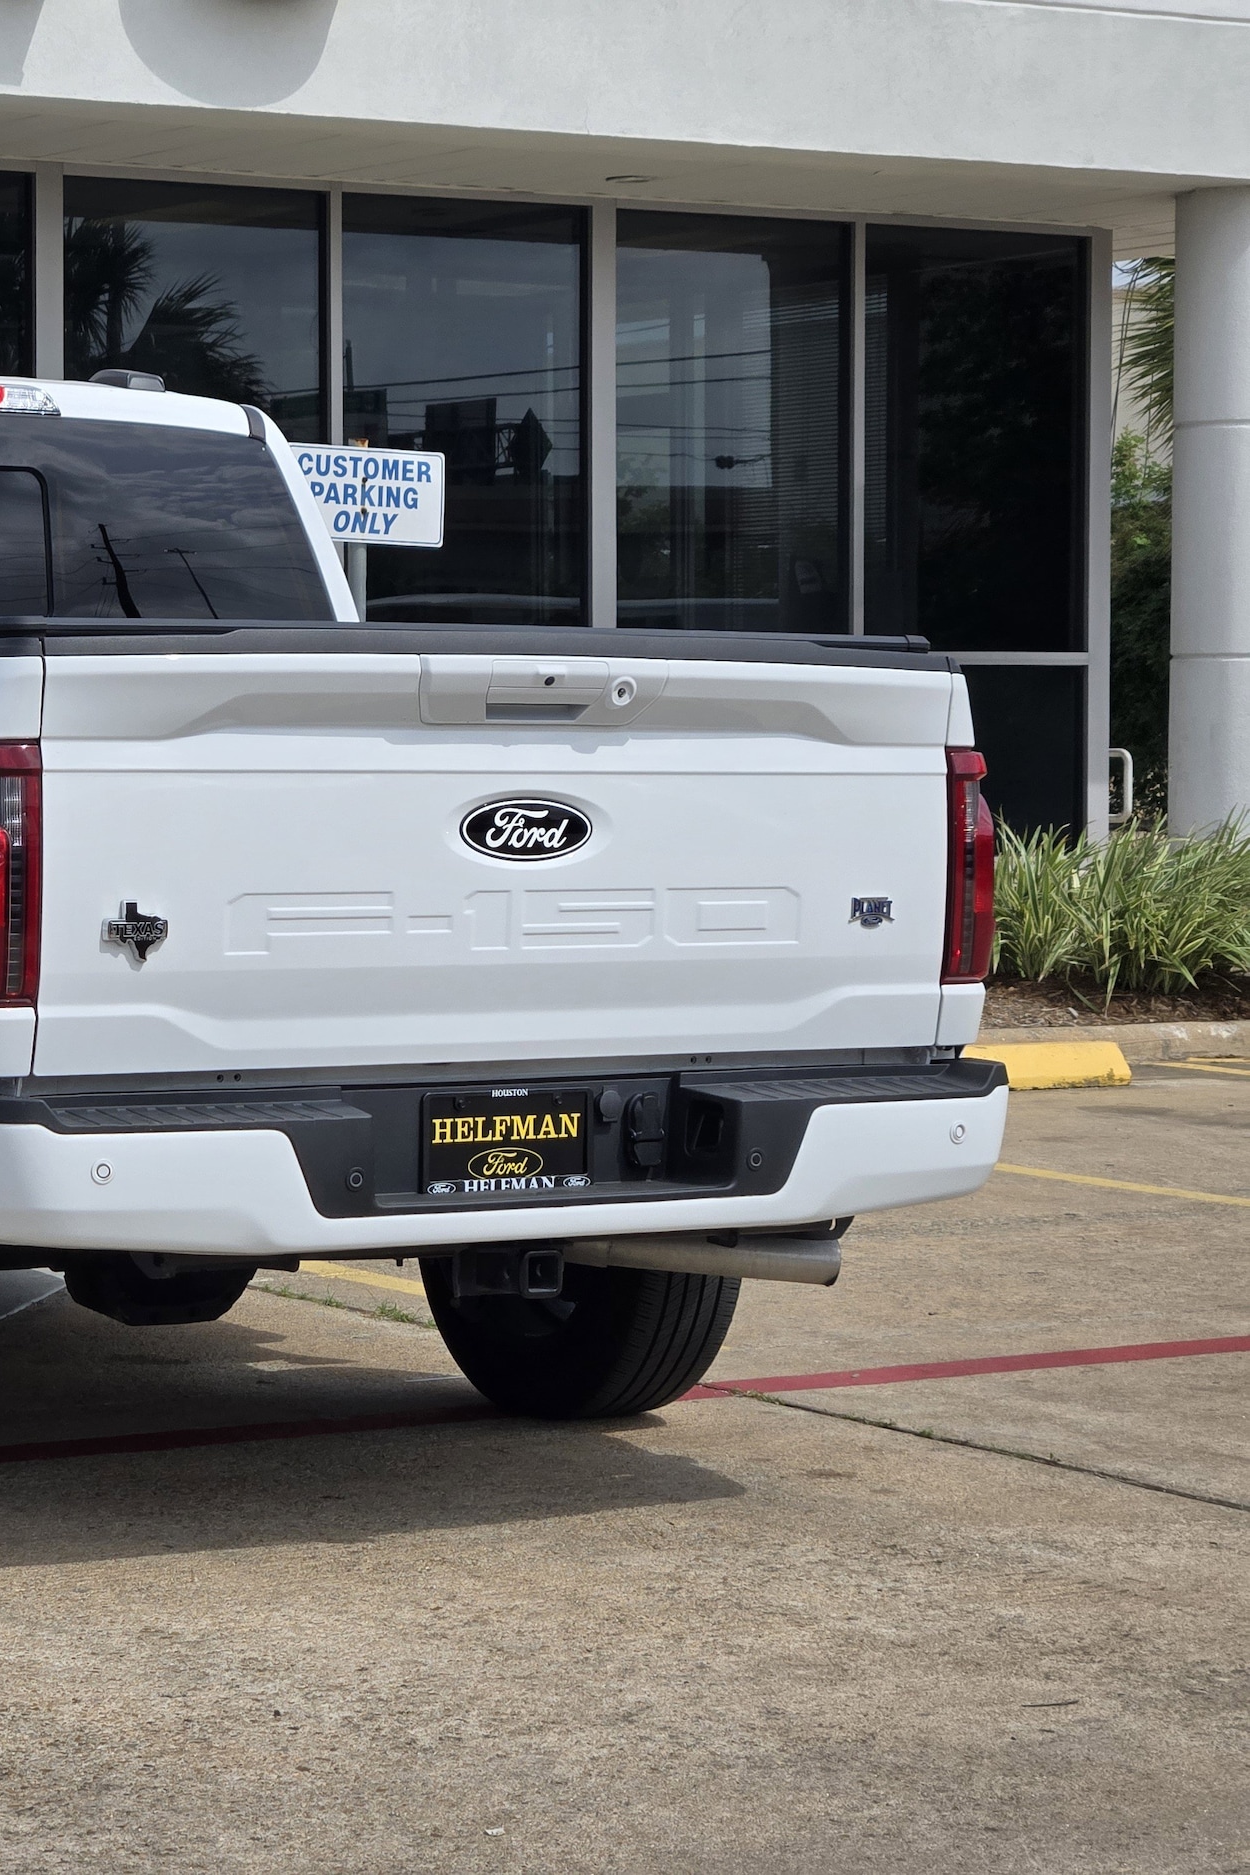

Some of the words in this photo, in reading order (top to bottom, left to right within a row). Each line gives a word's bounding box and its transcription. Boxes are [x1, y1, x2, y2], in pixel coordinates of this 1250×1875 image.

[298, 453, 432, 483] CUSTOMER
[310, 481, 419, 509] PARKING
[333, 510, 399, 535] ONLY
[485, 806, 567, 850] Ford
[851, 897, 892, 919] PLANET
[111, 921, 165, 937] TEXAS
[224, 887, 802, 955] F-150
[491, 1088, 529, 1098] HOUSTON
[432, 1112, 581, 1144] HELFMAN
[482, 1151, 529, 1176] Ford
[568, 1177, 586, 1187] Ford
